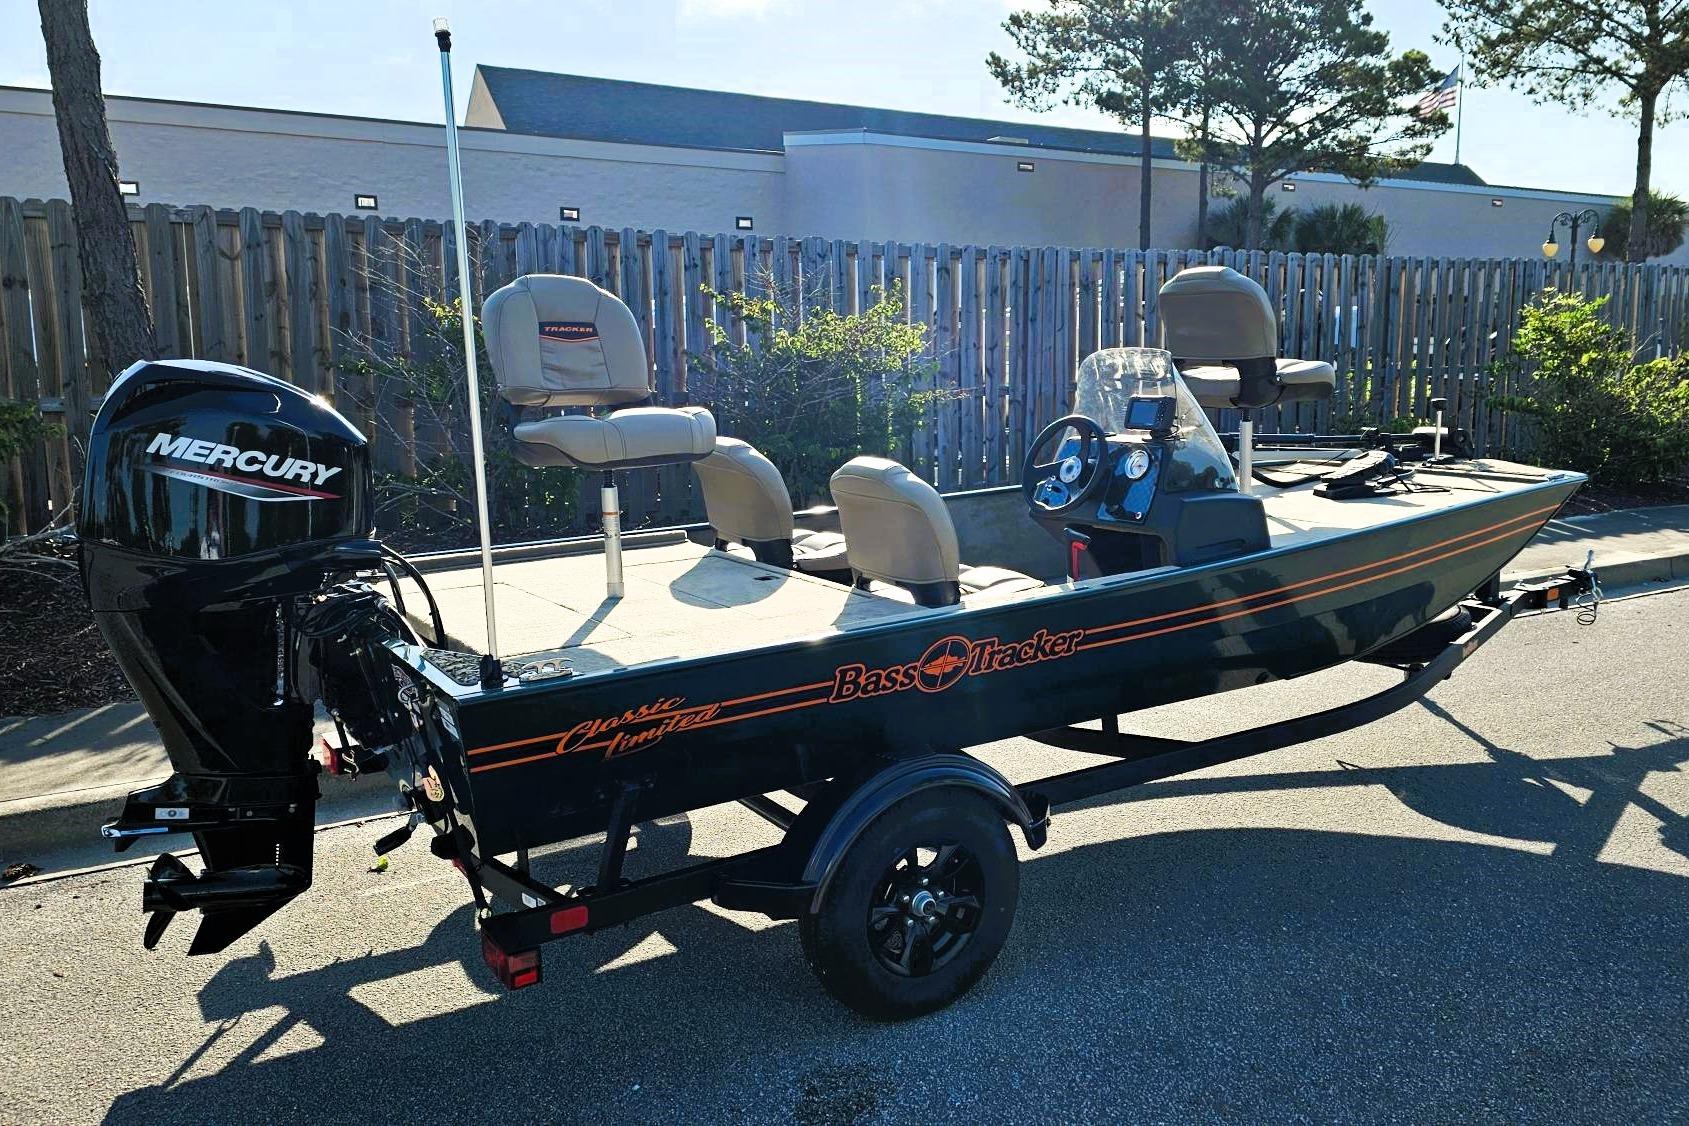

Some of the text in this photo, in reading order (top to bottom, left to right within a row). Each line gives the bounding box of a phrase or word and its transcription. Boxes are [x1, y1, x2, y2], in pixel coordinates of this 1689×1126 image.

[543, 325, 593, 333] TRACKER
[145, 432, 342, 486] MERCURY
[829, 629, 1083, 703] Bass Tracker
[556, 697, 686, 754] Classic
